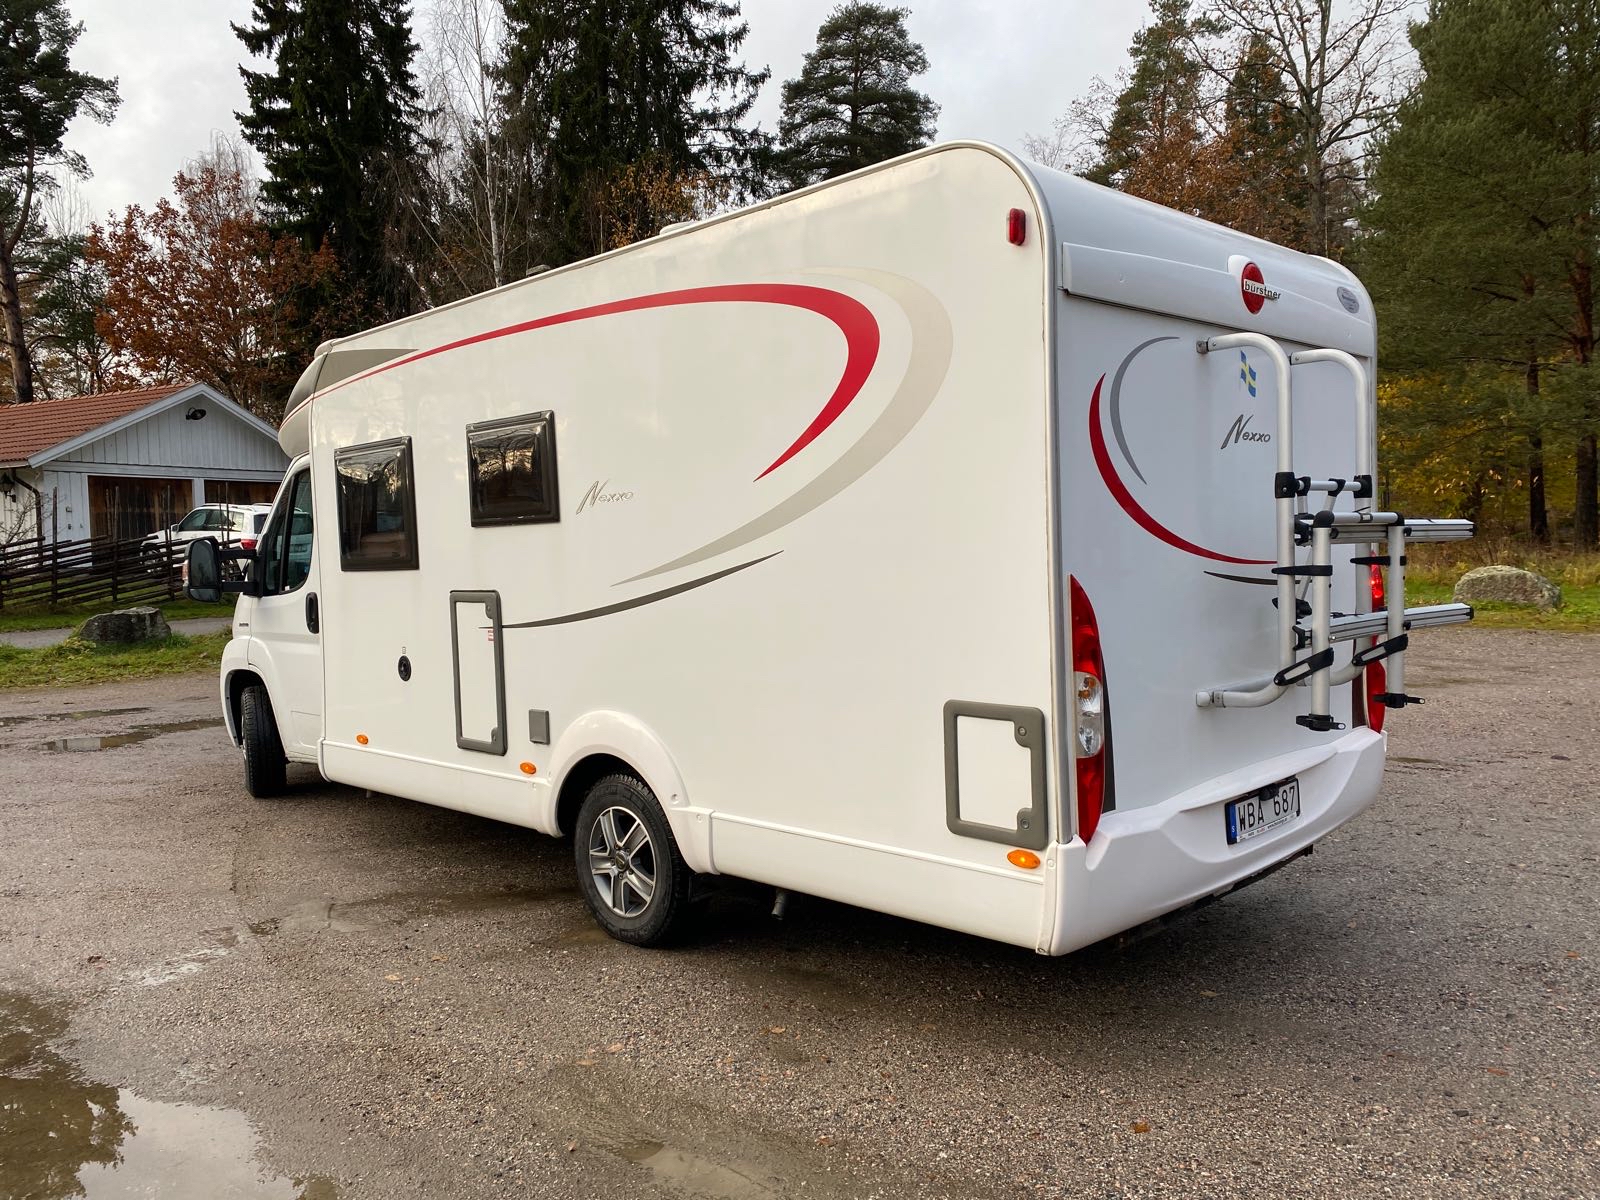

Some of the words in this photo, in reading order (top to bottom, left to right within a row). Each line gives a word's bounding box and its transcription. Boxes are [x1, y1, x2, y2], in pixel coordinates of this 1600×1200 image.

[1244, 280, 1281, 300] bürstner
[1220, 414, 1271, 450] Nexxo
[575, 479, 634, 515] Nexxo
[1238, 797, 1265, 832] WBA
[1273, 785, 1295, 816] 687
[1231, 825, 1236, 833] S
